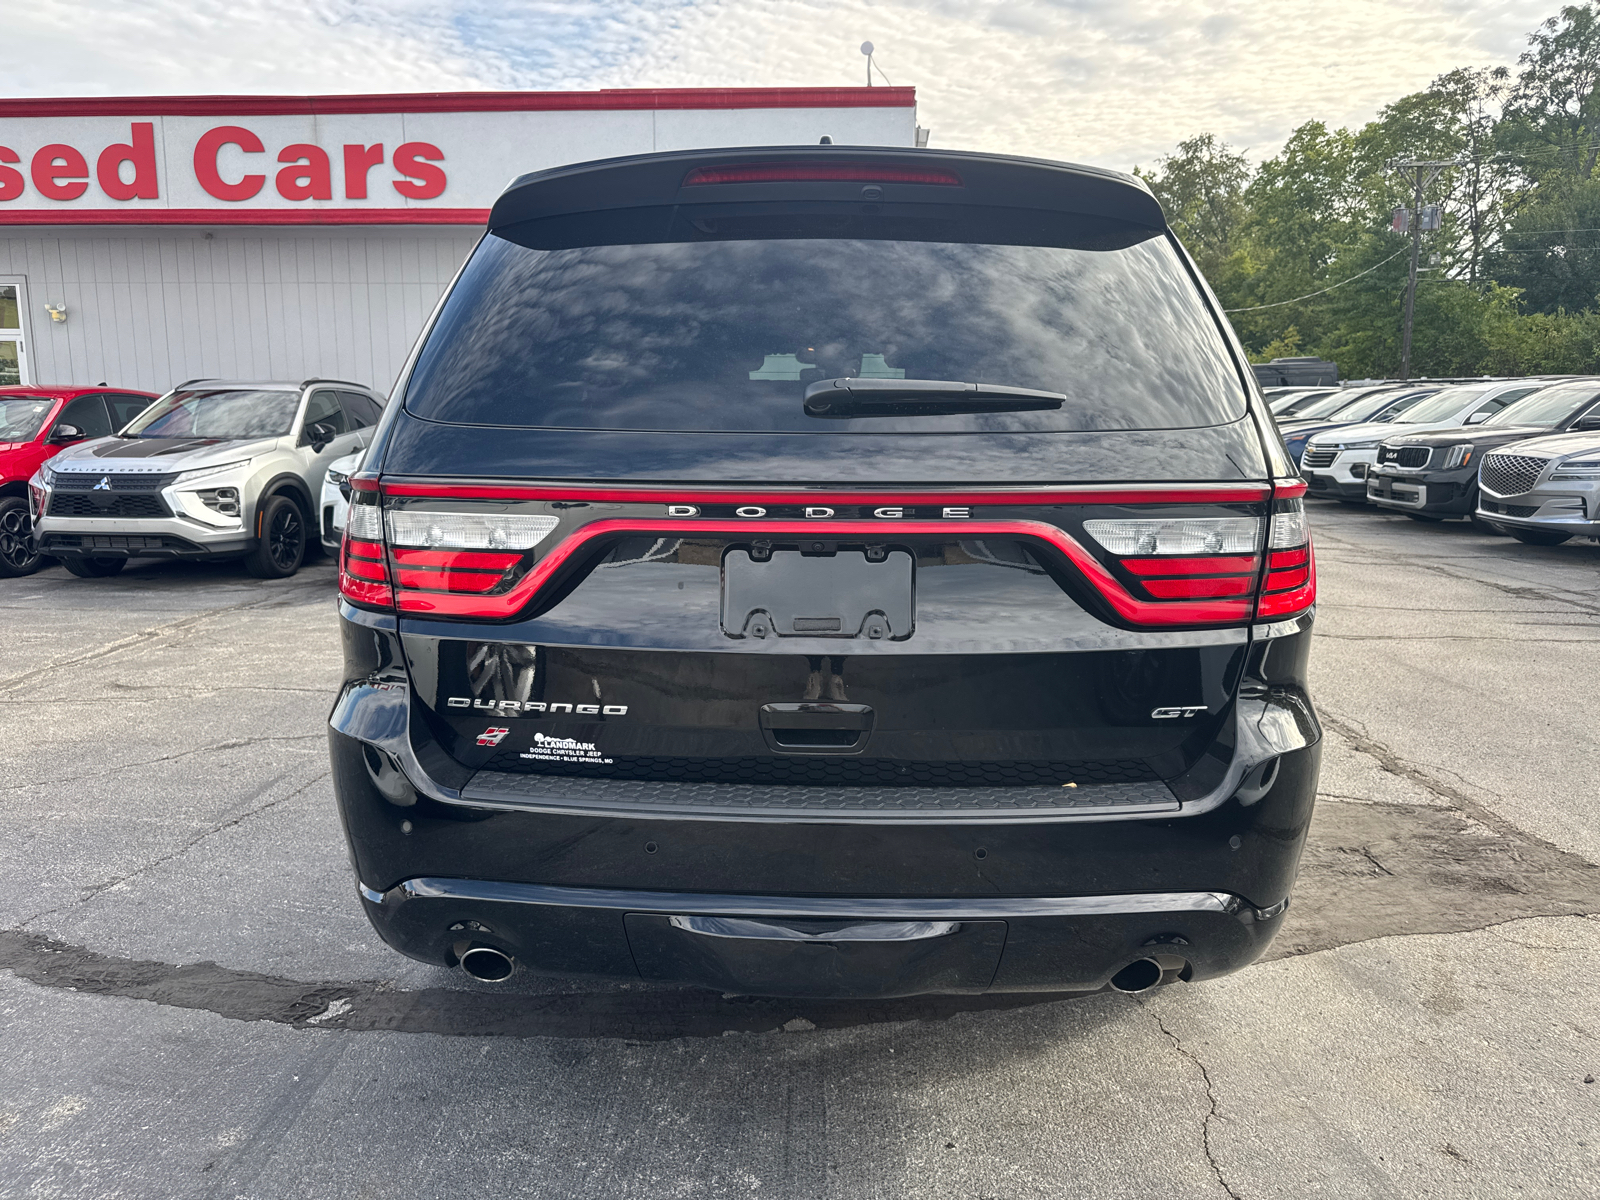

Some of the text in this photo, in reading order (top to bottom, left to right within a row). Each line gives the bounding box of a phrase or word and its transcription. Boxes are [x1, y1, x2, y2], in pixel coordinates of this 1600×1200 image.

[193, 125, 447, 202] Cars
[668, 505, 971, 519] DODGE
[447, 697, 629, 716] DURANGO
[1151, 705, 1209, 719] GT
[544, 740, 596, 751] LANDMARK
[519, 753, 561, 761] INDEPENDENCE
[552, 749, 585, 757] CHRYSLER
